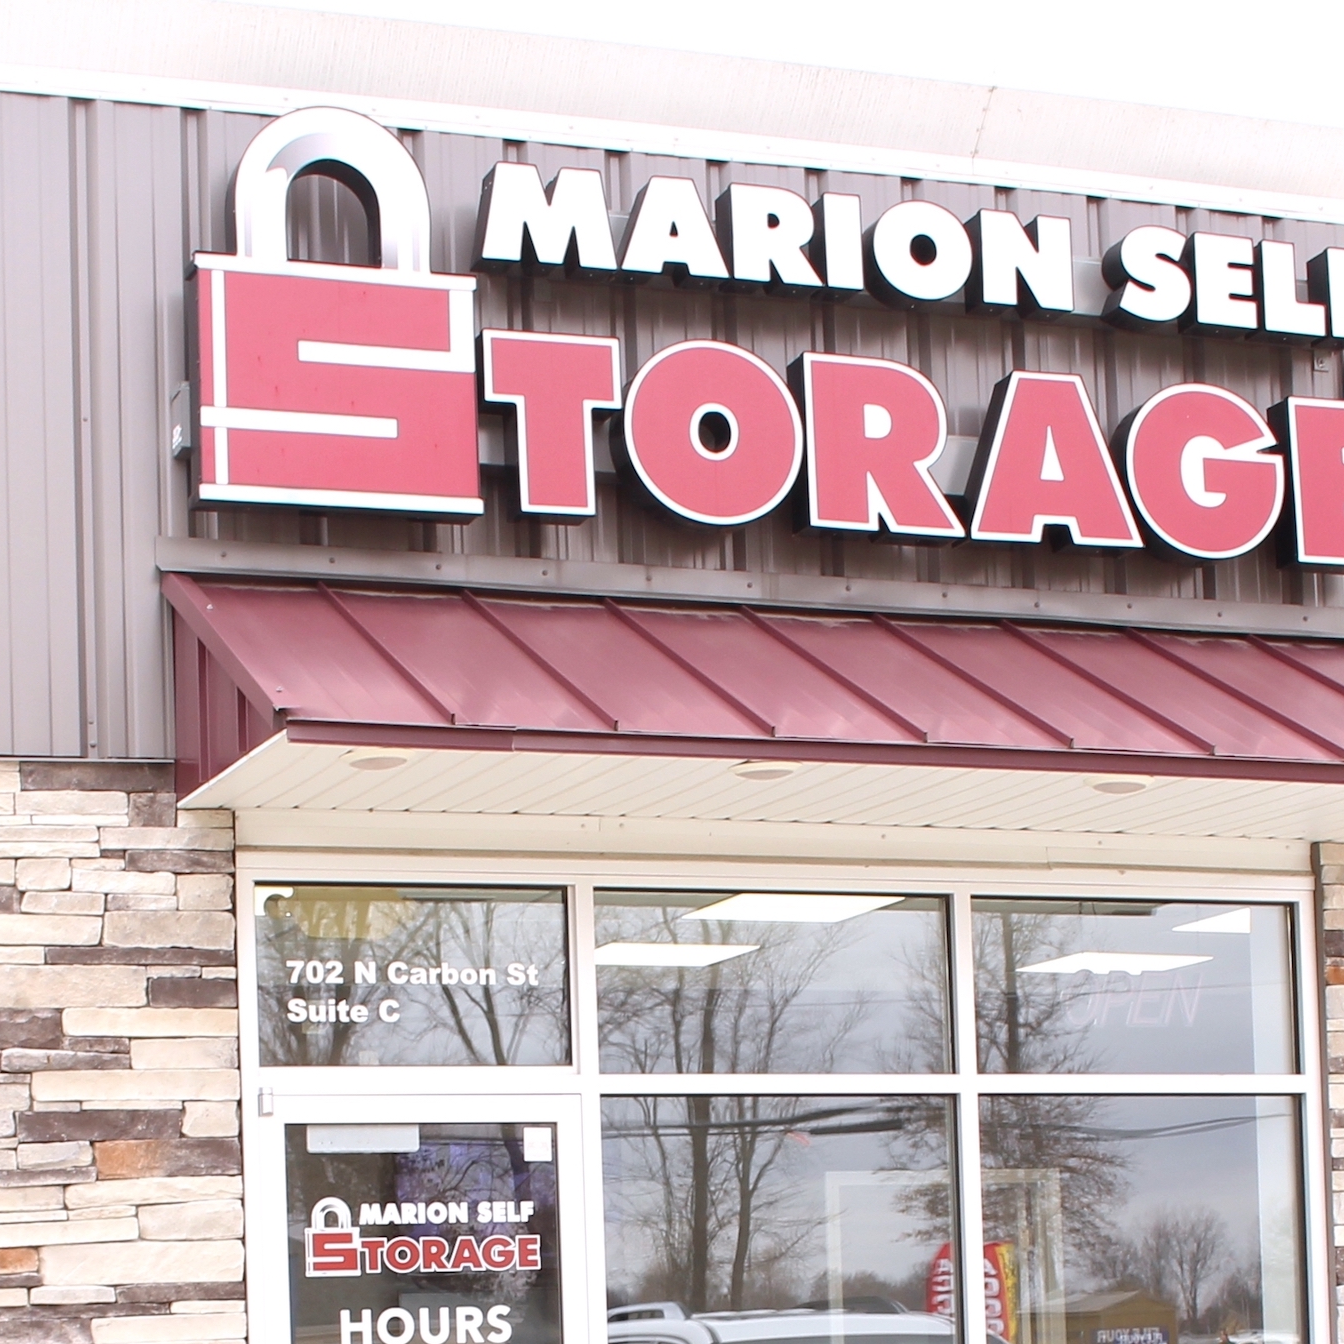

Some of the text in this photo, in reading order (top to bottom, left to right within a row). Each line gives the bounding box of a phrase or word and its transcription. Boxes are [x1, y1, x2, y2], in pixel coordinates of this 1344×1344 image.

[477, 161, 1075, 318] MARION
[286, 961, 539, 986] 702 N Carbon St
[287, 998, 401, 1023] Suite C
[1059, 969, 1203, 1027] OPEN
[359, 1201, 534, 1226] MARION SELF
[305, 1228, 541, 1277] STORAGE
